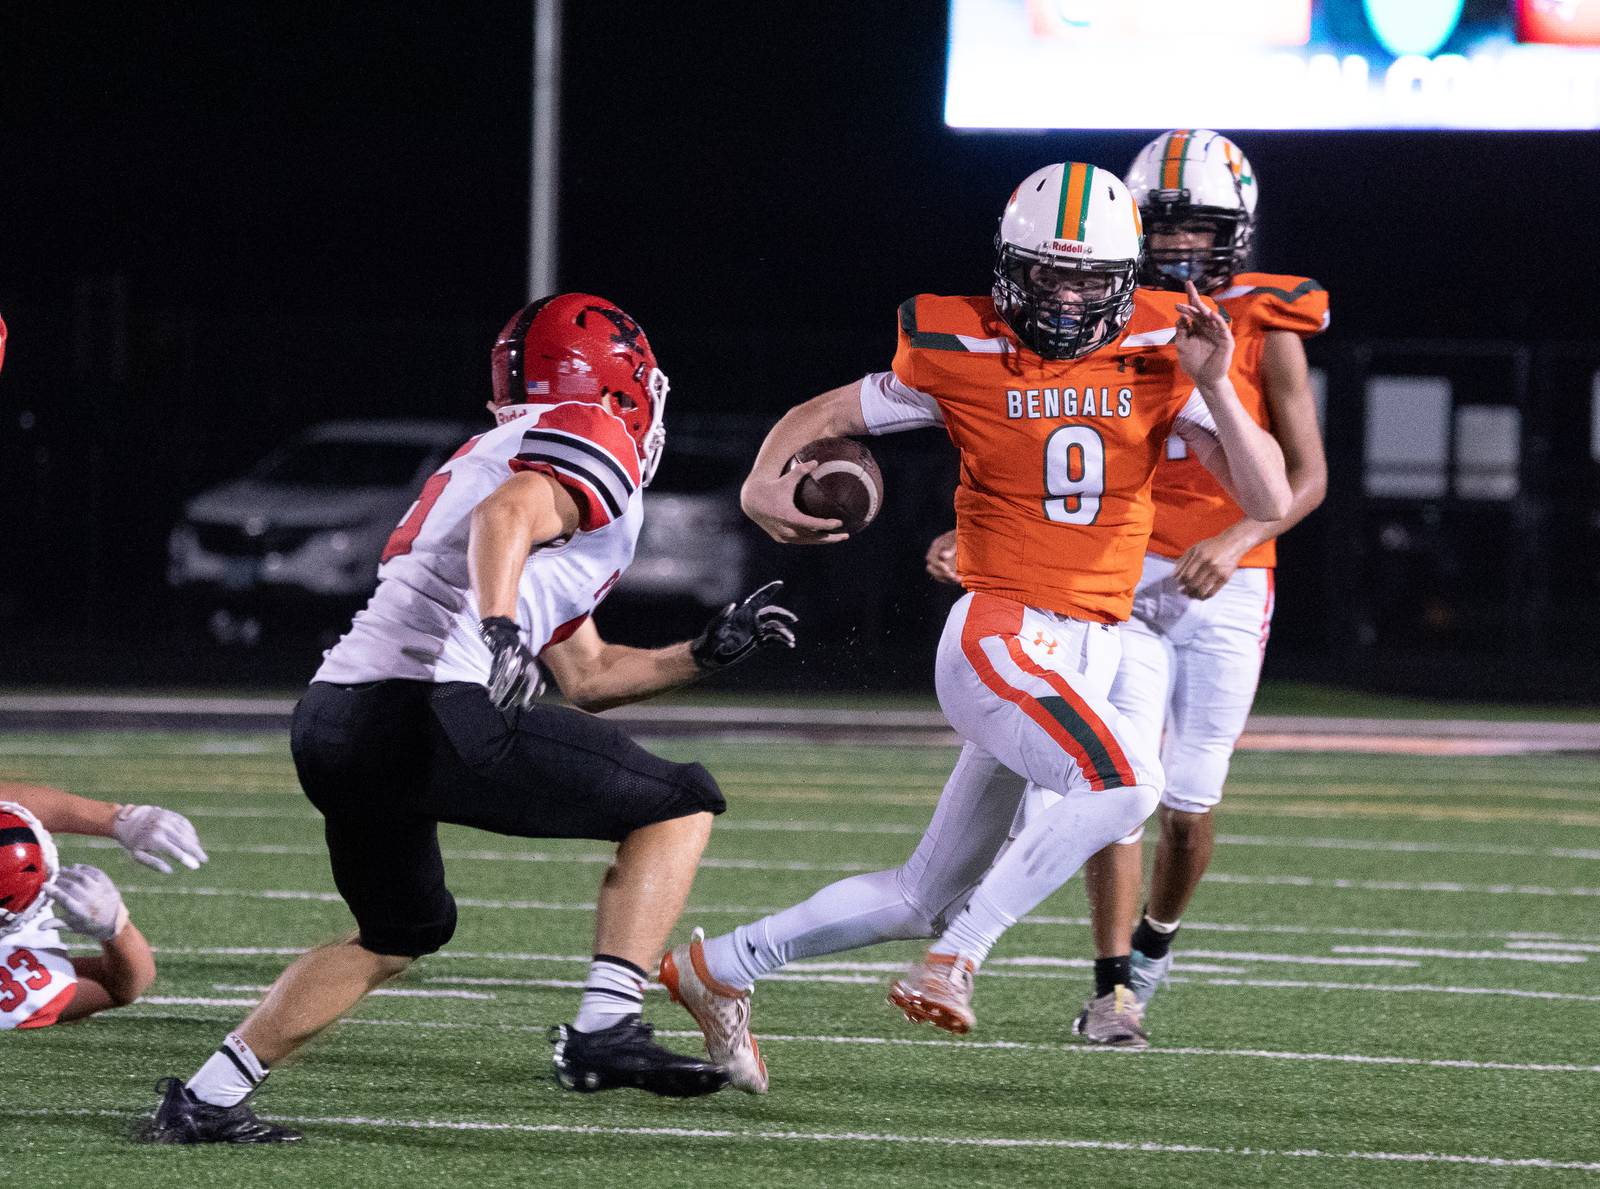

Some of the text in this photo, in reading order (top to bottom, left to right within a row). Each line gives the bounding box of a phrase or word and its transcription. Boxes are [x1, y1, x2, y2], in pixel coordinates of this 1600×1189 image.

[1052, 241, 1083, 253] Riddell
[1007, 387, 1133, 419] BENGALS
[1042, 423, 1105, 527] 9
[0, 949, 53, 1013] 33
